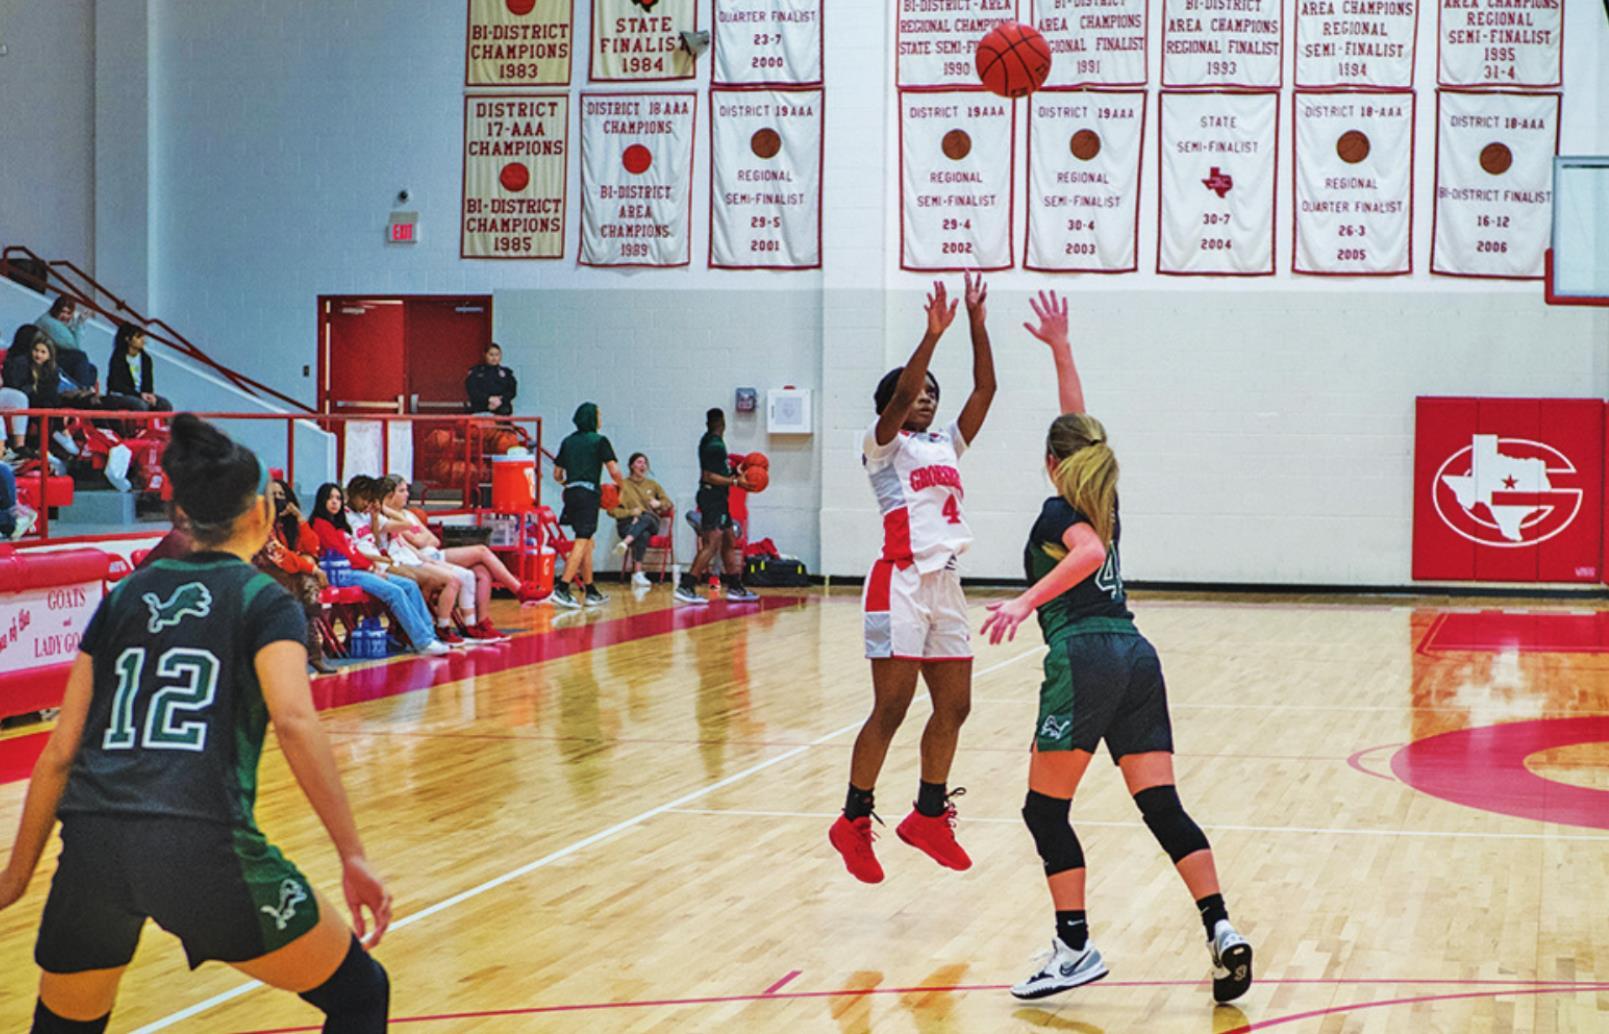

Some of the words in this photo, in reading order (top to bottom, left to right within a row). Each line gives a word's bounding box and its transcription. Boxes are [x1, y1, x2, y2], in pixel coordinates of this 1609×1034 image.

[1301, 2, 1335, 16] AREA
[1342, 1, 1414, 16] CHAMPIONS
[719, 11, 767, 23] QUARTER
[771, 11, 816, 22] FINALIST
[1038, 18, 1069, 32] AREA
[1080, 14, 1143, 30] CHAMPIONS
[1466, 11, 1534, 26] REGIONAL
[615, 16, 672, 33] STATE
[900, 19, 952, 33] REGIONAL
[1167, 18, 1203, 33] AREA
[1210, 18, 1279, 34] CHAMPIONS
[1322, 21, 1389, 37] REGIONAL
[472, 24, 569, 40] BI-DISTRICT
[1448, 29, 1552, 45] SEMI-FINALIST
[753, 33, 782, 46] 23-7
[1095, 36, 1145, 52] FINALIST
[471, 43, 568, 60] CHAMPIONS
[899, 41, 931, 55] STATE
[1166, 40, 1222, 54] REGIONAL
[1228, 40, 1280, 56] FINALIST
[1305, 41, 1405, 58] SEMI-FINALIST
[1484, 47, 1516, 61] 1995
[622, 57, 663, 73] 1984
[751, 56, 784, 69] 2000
[943, 61, 971, 76] 1990
[1076, 60, 1101, 74] 1991
[1207, 61, 1238, 76] 1993
[499, 63, 538, 79] 1983
[1484, 65, 1516, 80] 31-4
[476, 102, 558, 118] DISTRICT
[587, 101, 640, 116] DISTRICT
[719, 105, 769, 118] DISTRICT
[910, 106, 958, 118] DISTRICT
[1038, 106, 1088, 119] DISTRICT
[1305, 105, 1354, 118] DISTRICT
[603, 120, 672, 134] CHAMPIONS
[1200, 115, 1237, 128] STATE
[1450, 115, 1499, 128] DISTRICT
[487, 122, 545, 137] 17-AAA
[468, 140, 564, 156] CHAMPIONS
[1177, 141, 1258, 153] SEMI-FINALIST
[737, 169, 793, 182] REGIONAL
[930, 171, 983, 183] REGIONAL
[1057, 172, 1109, 184] REGIONAL
[1325, 177, 1378, 190] REGIONAL
[601, 185, 671, 200] BI-DISTRICT
[726, 192, 804, 205] SEMI-FINALIST
[1439, 187, 1499, 202] BI-DISTRICT
[1503, 190, 1551, 204] FINALIST
[467, 198, 562, 214] BI-DISTRICT
[917, 195, 996, 207] SEMI-FINALIST
[1044, 196, 1121, 208] SEMI-FINALIST
[1302, 201, 1350, 213] QUARTER
[1354, 201, 1403, 214] FINALIST
[619, 205, 653, 218] AREA
[466, 217, 561, 233] CHAMPIONS
[751, 216, 781, 228] 29-5
[942, 218, 971, 230] 29-4
[1067, 219, 1095, 231] 30-4
[1203, 213, 1231, 225] 30-7
[1477, 215, 1510, 228] 16-12
[601, 225, 669, 239] CHAMPIONS
[1338, 225, 1366, 237] 26-3
[494, 236, 532, 252] 1985
[751, 240, 780, 252] 2001
[942, 242, 972, 254] 2002
[1065, 243, 1096, 255] 2003
[1201, 239, 1232, 251] 2004
[1476, 241, 1508, 253] 2006
[1337, 249, 1366, 261] 2005
[942, 494, 960, 524] 4
[1094, 540, 1123, 601] 4
[48, 587, 86, 611] GOATS
[34, 635, 62, 658] LADY
[103, 648, 219, 751] 12
